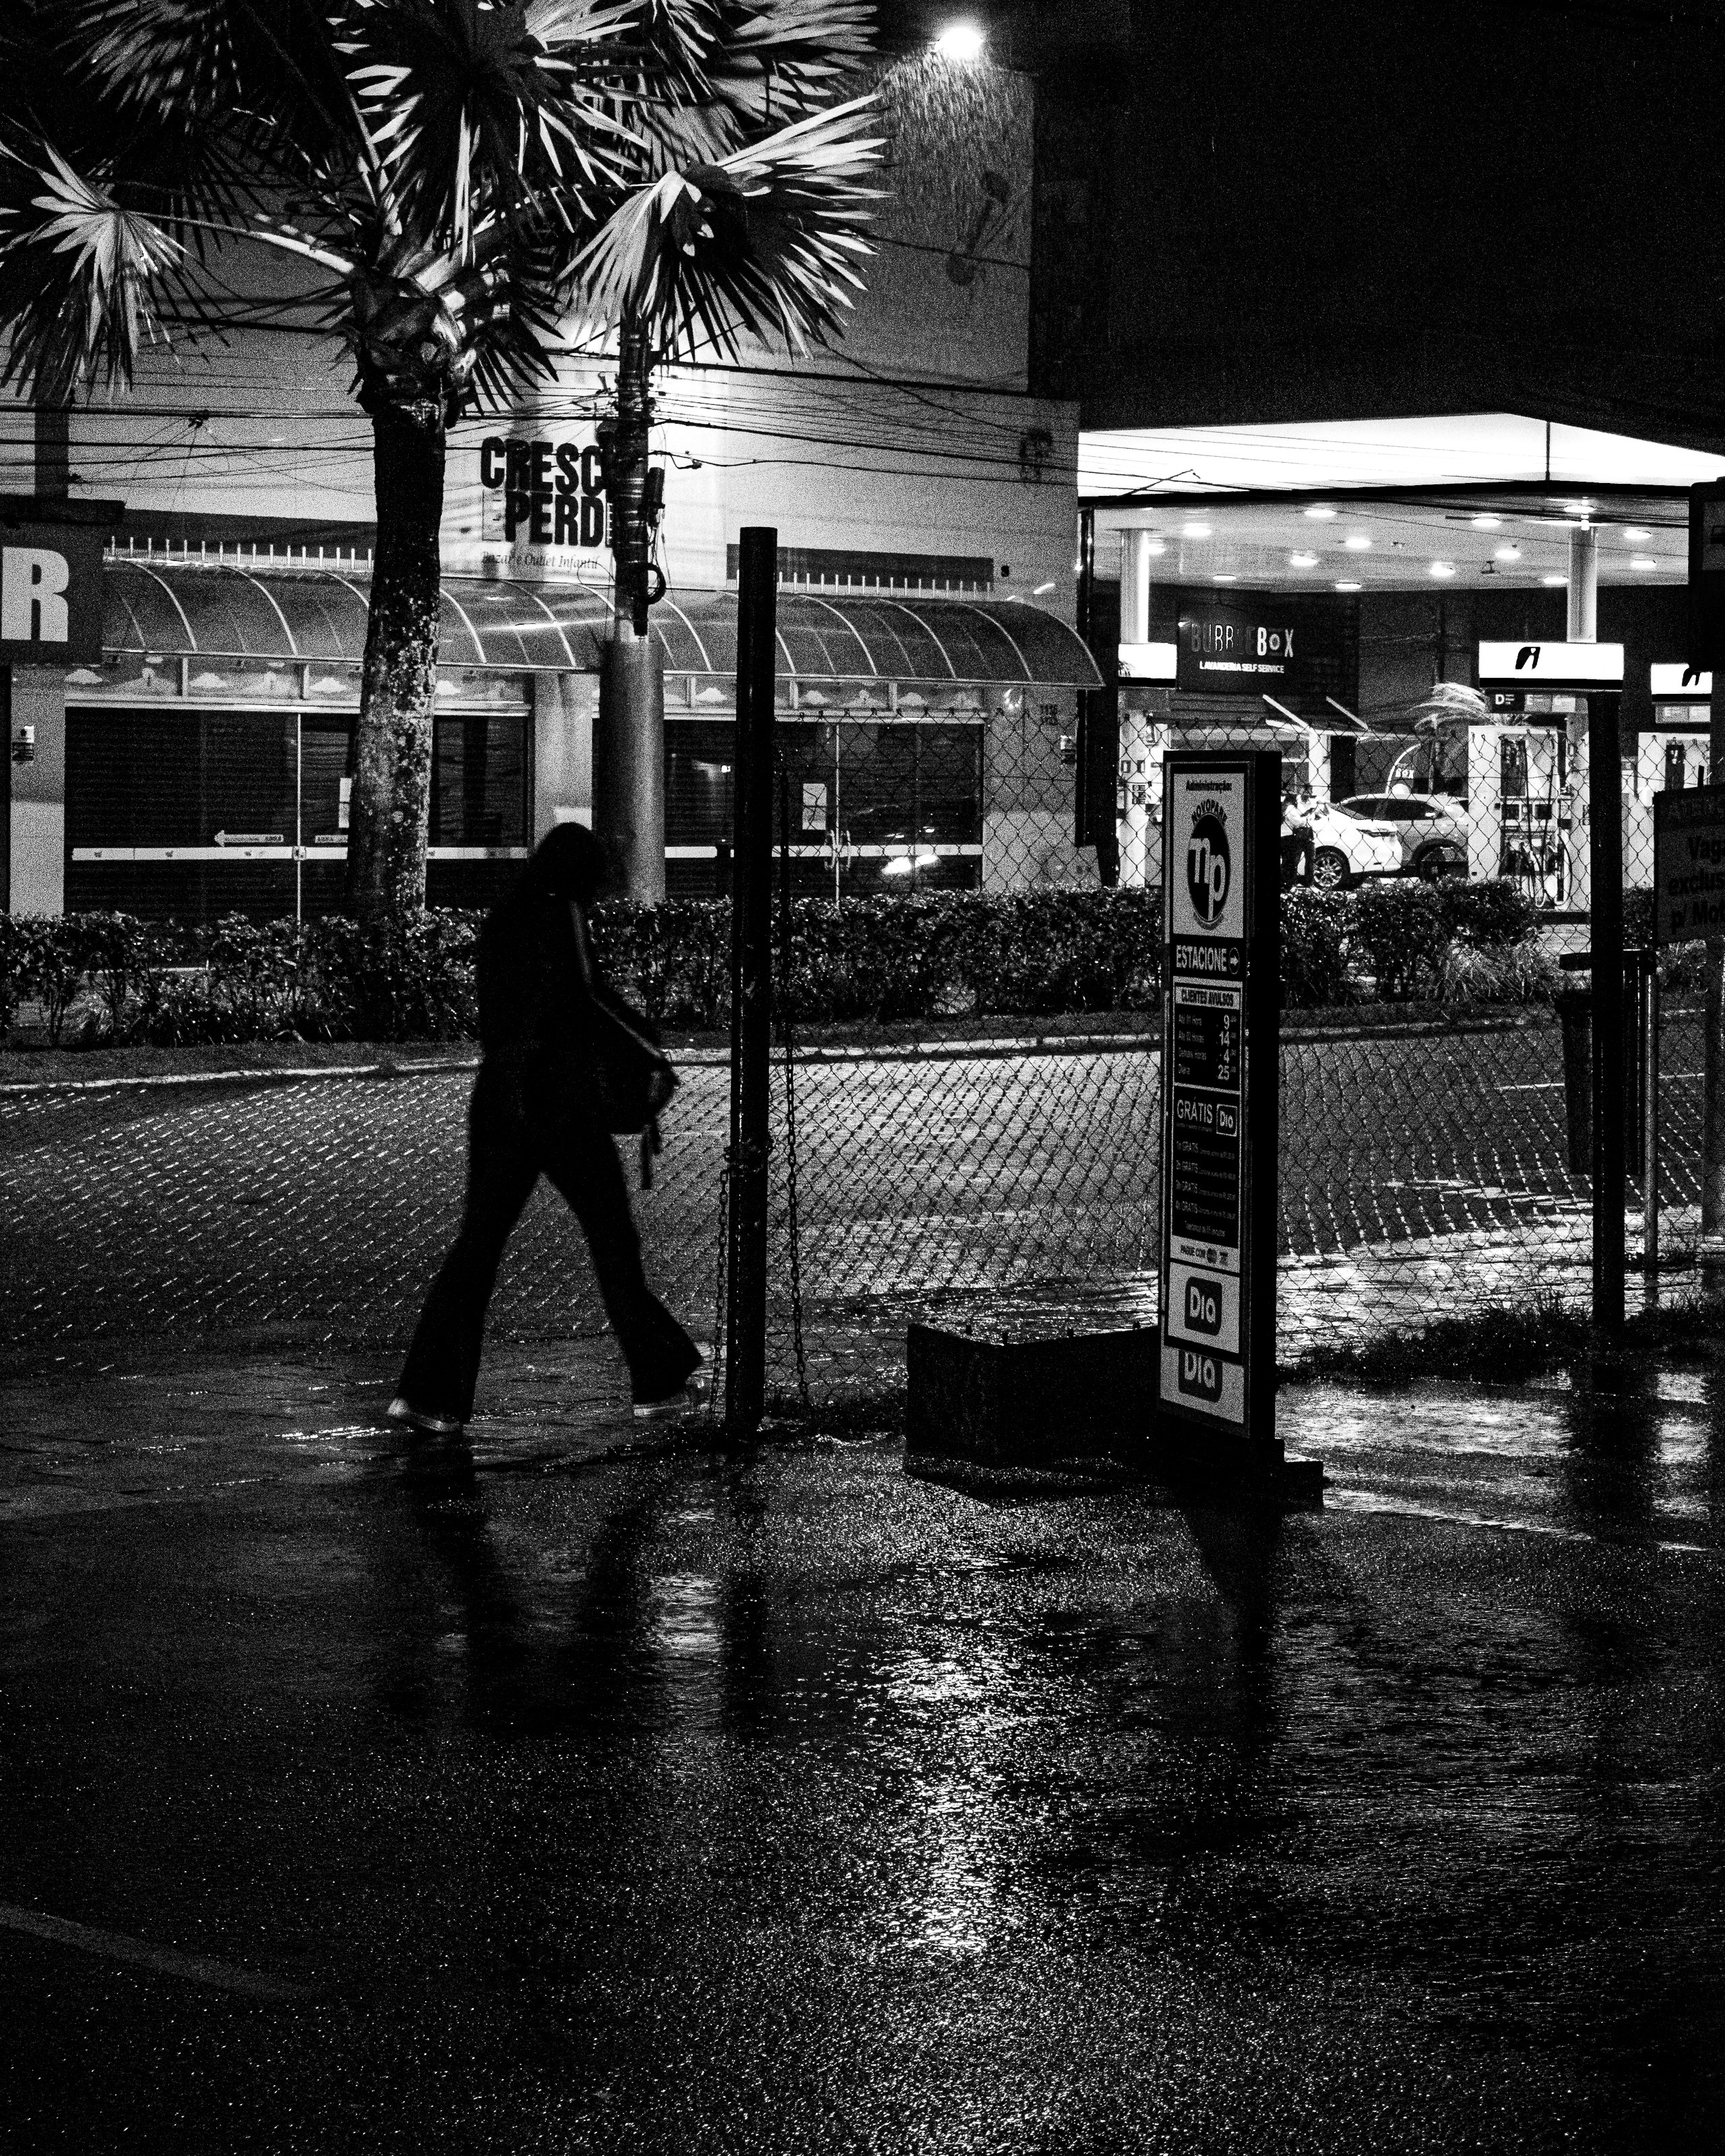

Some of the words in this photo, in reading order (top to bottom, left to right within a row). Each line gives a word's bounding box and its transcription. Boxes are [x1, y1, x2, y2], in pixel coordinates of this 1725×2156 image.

[481, 437, 604, 497] CRESC
[1, 546, 69, 643] R
[1199, 661, 1241, 672] LAVANDERIA
[1241, 663, 1257, 672] SELF
[1257, 664, 1284, 674] SERVICE
[1175, 944, 1228, 972] ESTACIONE
[1181, 988, 1207, 1004] CLIENTES
[1208, 992, 1234, 1007] AVULSOS
[1176, 1096, 1214, 1124] GRÁTIS
